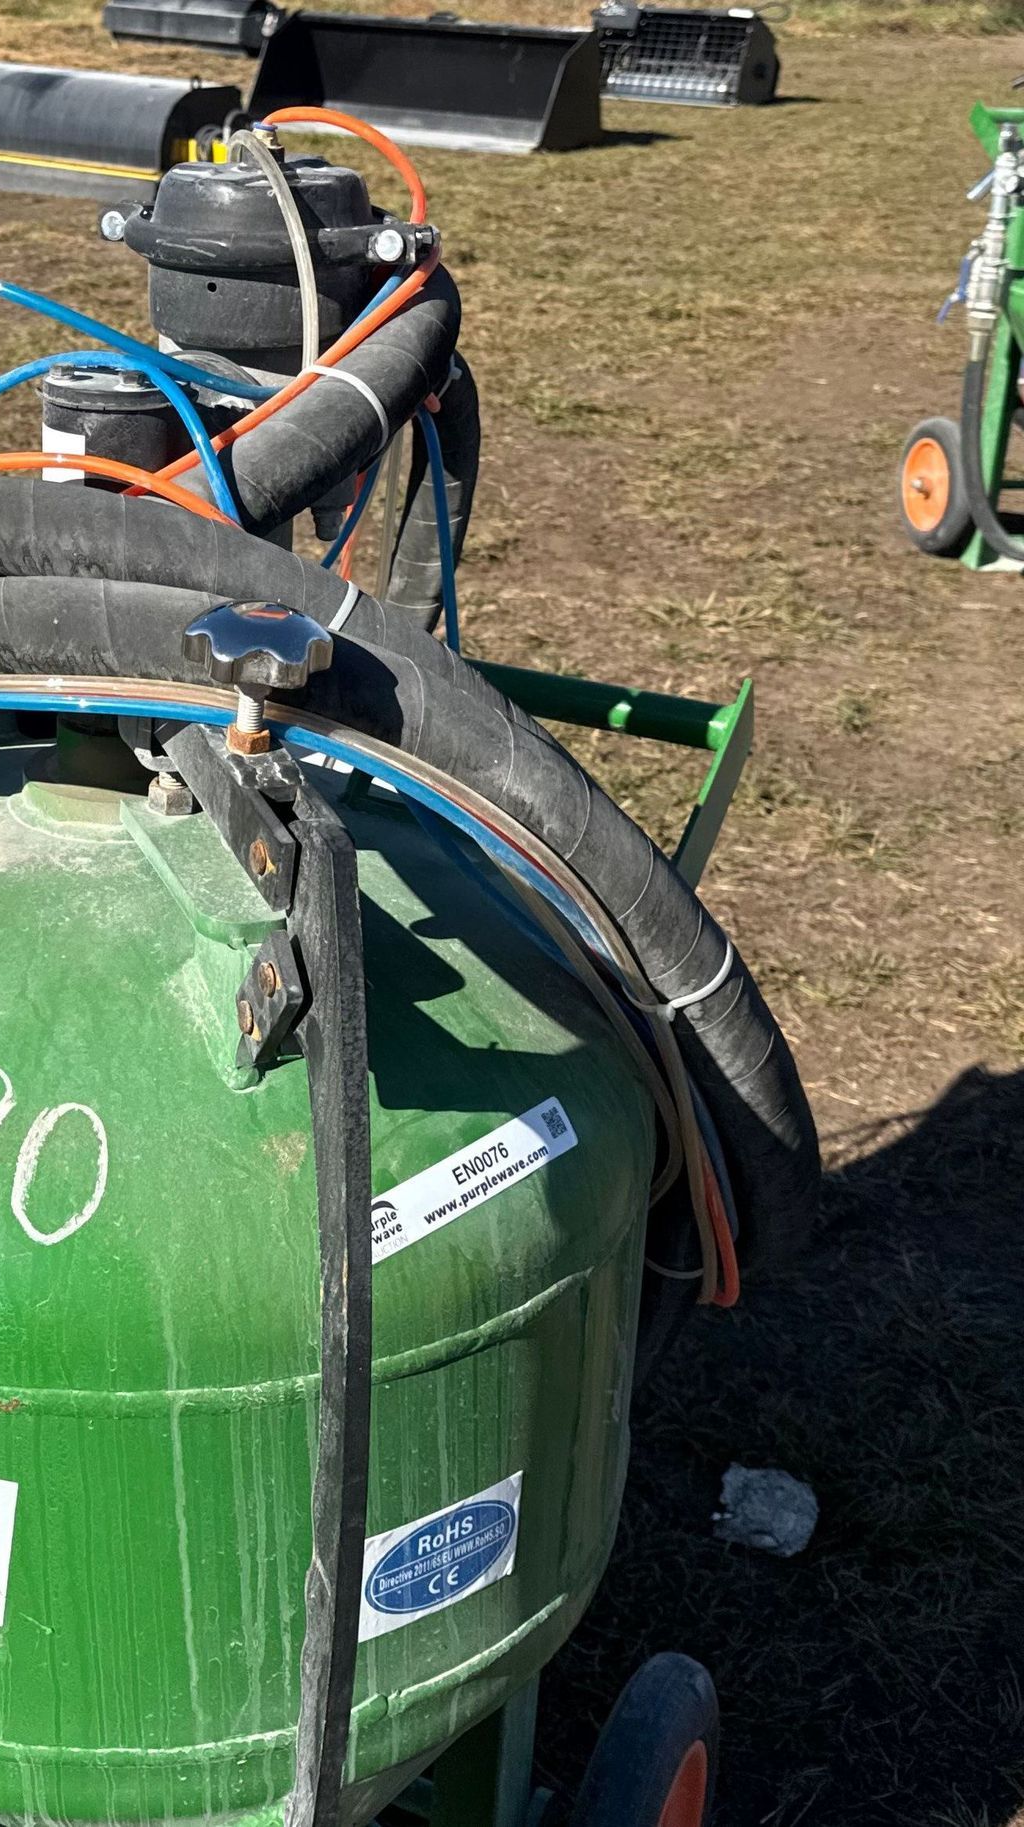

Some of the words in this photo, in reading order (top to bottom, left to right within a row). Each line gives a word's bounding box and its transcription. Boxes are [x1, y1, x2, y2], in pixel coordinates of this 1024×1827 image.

[452, 1142, 509, 1185] EN0076
[424, 1145, 549, 1224] www.purplewave.com
[371, 1211, 397, 1231] rple
[372, 1223, 402, 1244] wave
[418, 1515, 473, 1556] RoHS
[379, 1569, 413, 1591] Directive
